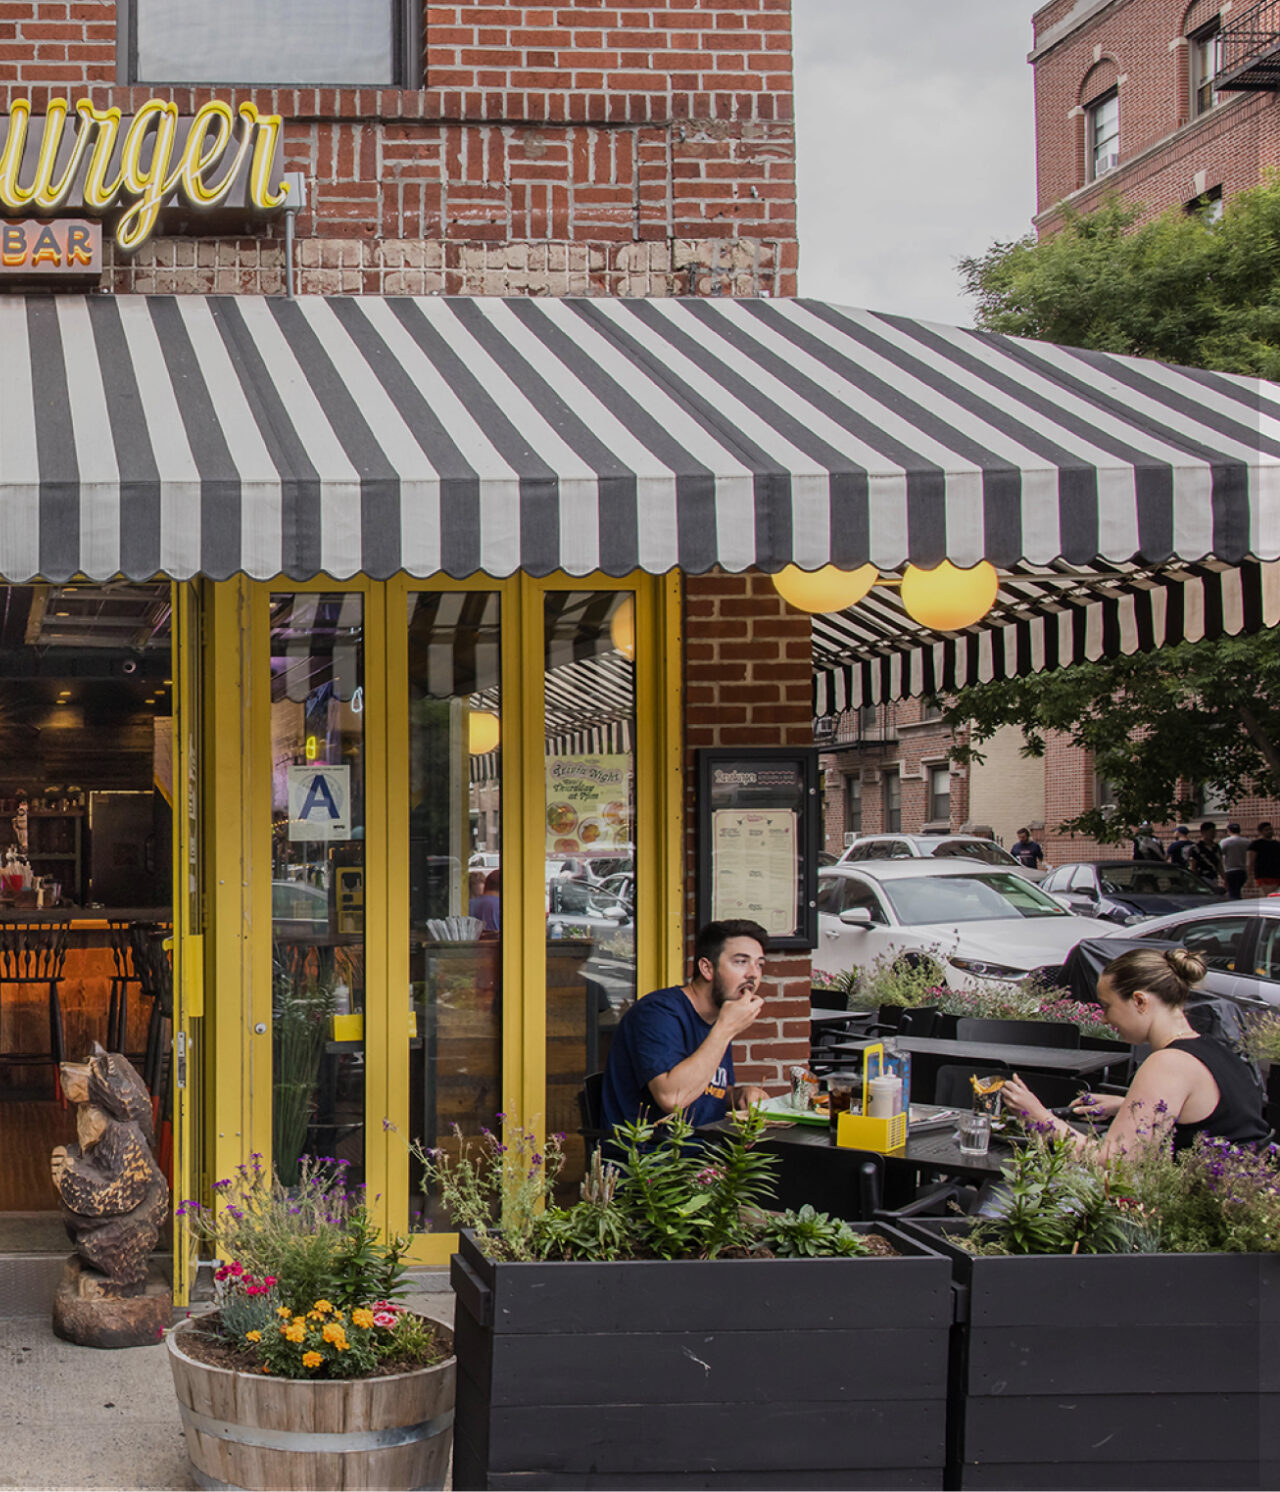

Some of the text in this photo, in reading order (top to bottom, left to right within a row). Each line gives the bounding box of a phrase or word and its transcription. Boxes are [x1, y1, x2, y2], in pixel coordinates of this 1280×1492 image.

[2, 225, 92, 267] BAR
[589, 768, 620, 782] Night
[298, 775, 340, 819] A
